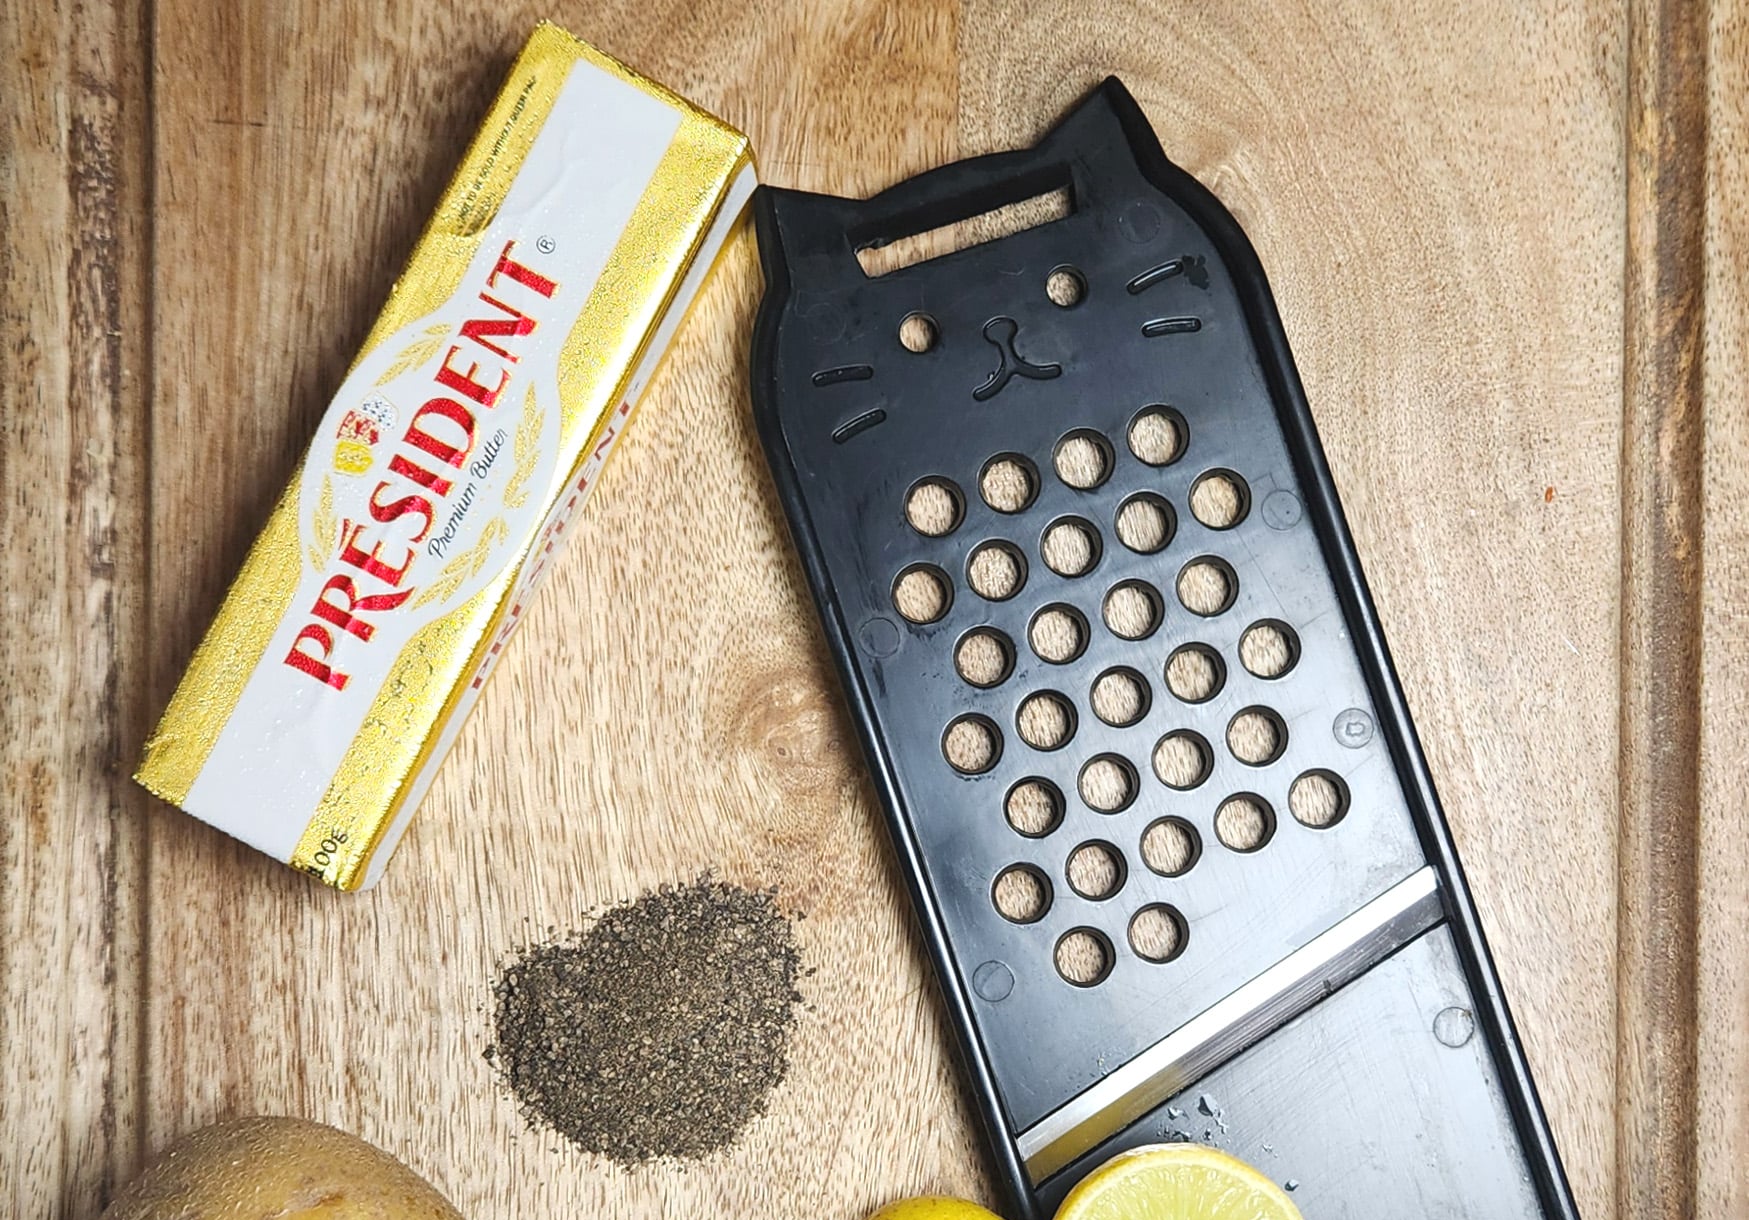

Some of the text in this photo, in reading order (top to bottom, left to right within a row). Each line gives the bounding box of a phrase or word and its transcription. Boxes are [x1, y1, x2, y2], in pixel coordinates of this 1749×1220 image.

[283, 239, 562, 692] PRÉSIDENT
[428, 428, 508, 559] Premium Butter
